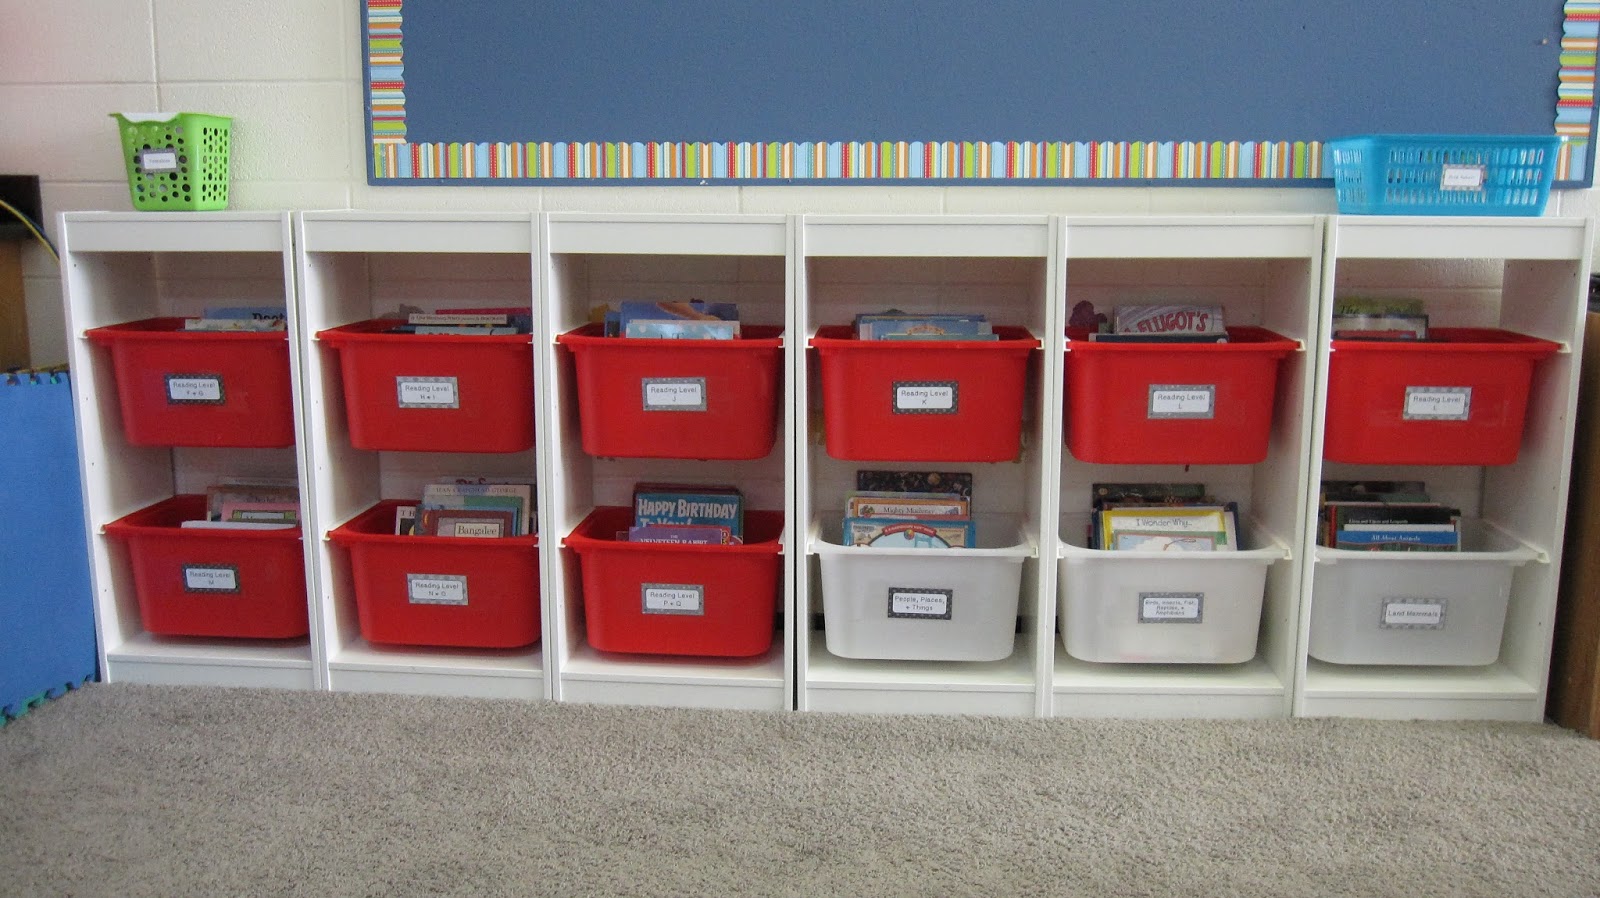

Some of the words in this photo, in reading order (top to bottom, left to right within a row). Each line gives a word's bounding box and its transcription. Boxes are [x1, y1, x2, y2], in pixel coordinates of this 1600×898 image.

[1124, 311, 1209, 333] ELLIGOT'S
[173, 381, 198, 389] Reading
[405, 384, 430, 392] Reading
[650, 386, 678, 394] Reading
[901, 389, 929, 397] Reading
[1157, 393, 1185, 401] Reading
[1413, 395, 1440, 403] Reading
[638, 498, 676, 517] HAPPY
[677, 498, 738, 519] BIRTHDAY
[883, 506, 904, 514] Mighty
[1141, 518, 1172, 526] Wonder
[1172, 518, 1193, 527] Why...
[457, 525, 497, 536] Bangalee
[415, 581, 440, 590] Reading
[650, 591, 676, 599] Reading
[894, 595, 919, 603] People,
[920, 596, 945, 604] Places,
